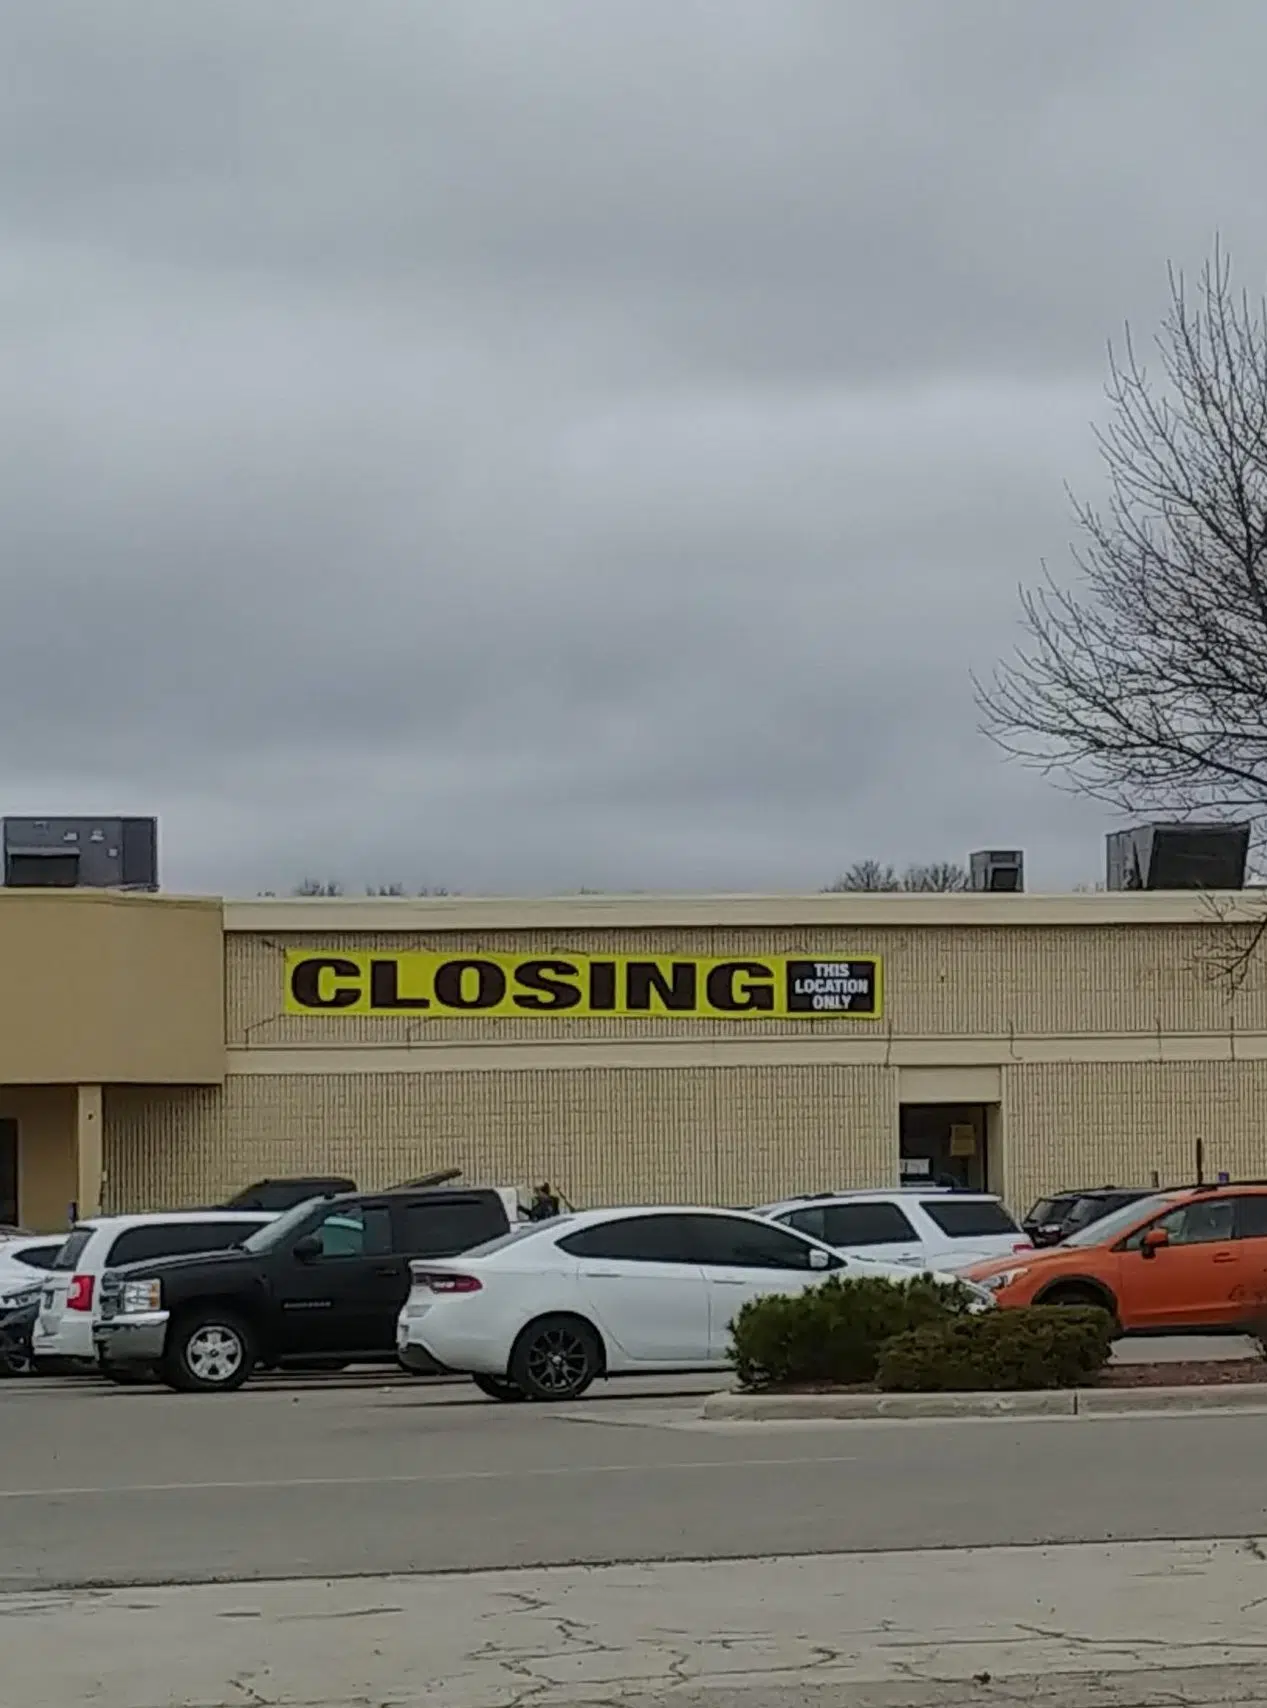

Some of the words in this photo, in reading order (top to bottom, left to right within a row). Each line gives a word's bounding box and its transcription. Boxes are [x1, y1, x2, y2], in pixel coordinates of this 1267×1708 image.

[813, 962, 850, 978] THIS
[290, 958, 776, 1012] CLOSING
[794, 978, 869, 995] LOCATION
[811, 994, 852, 1010] ONLY
